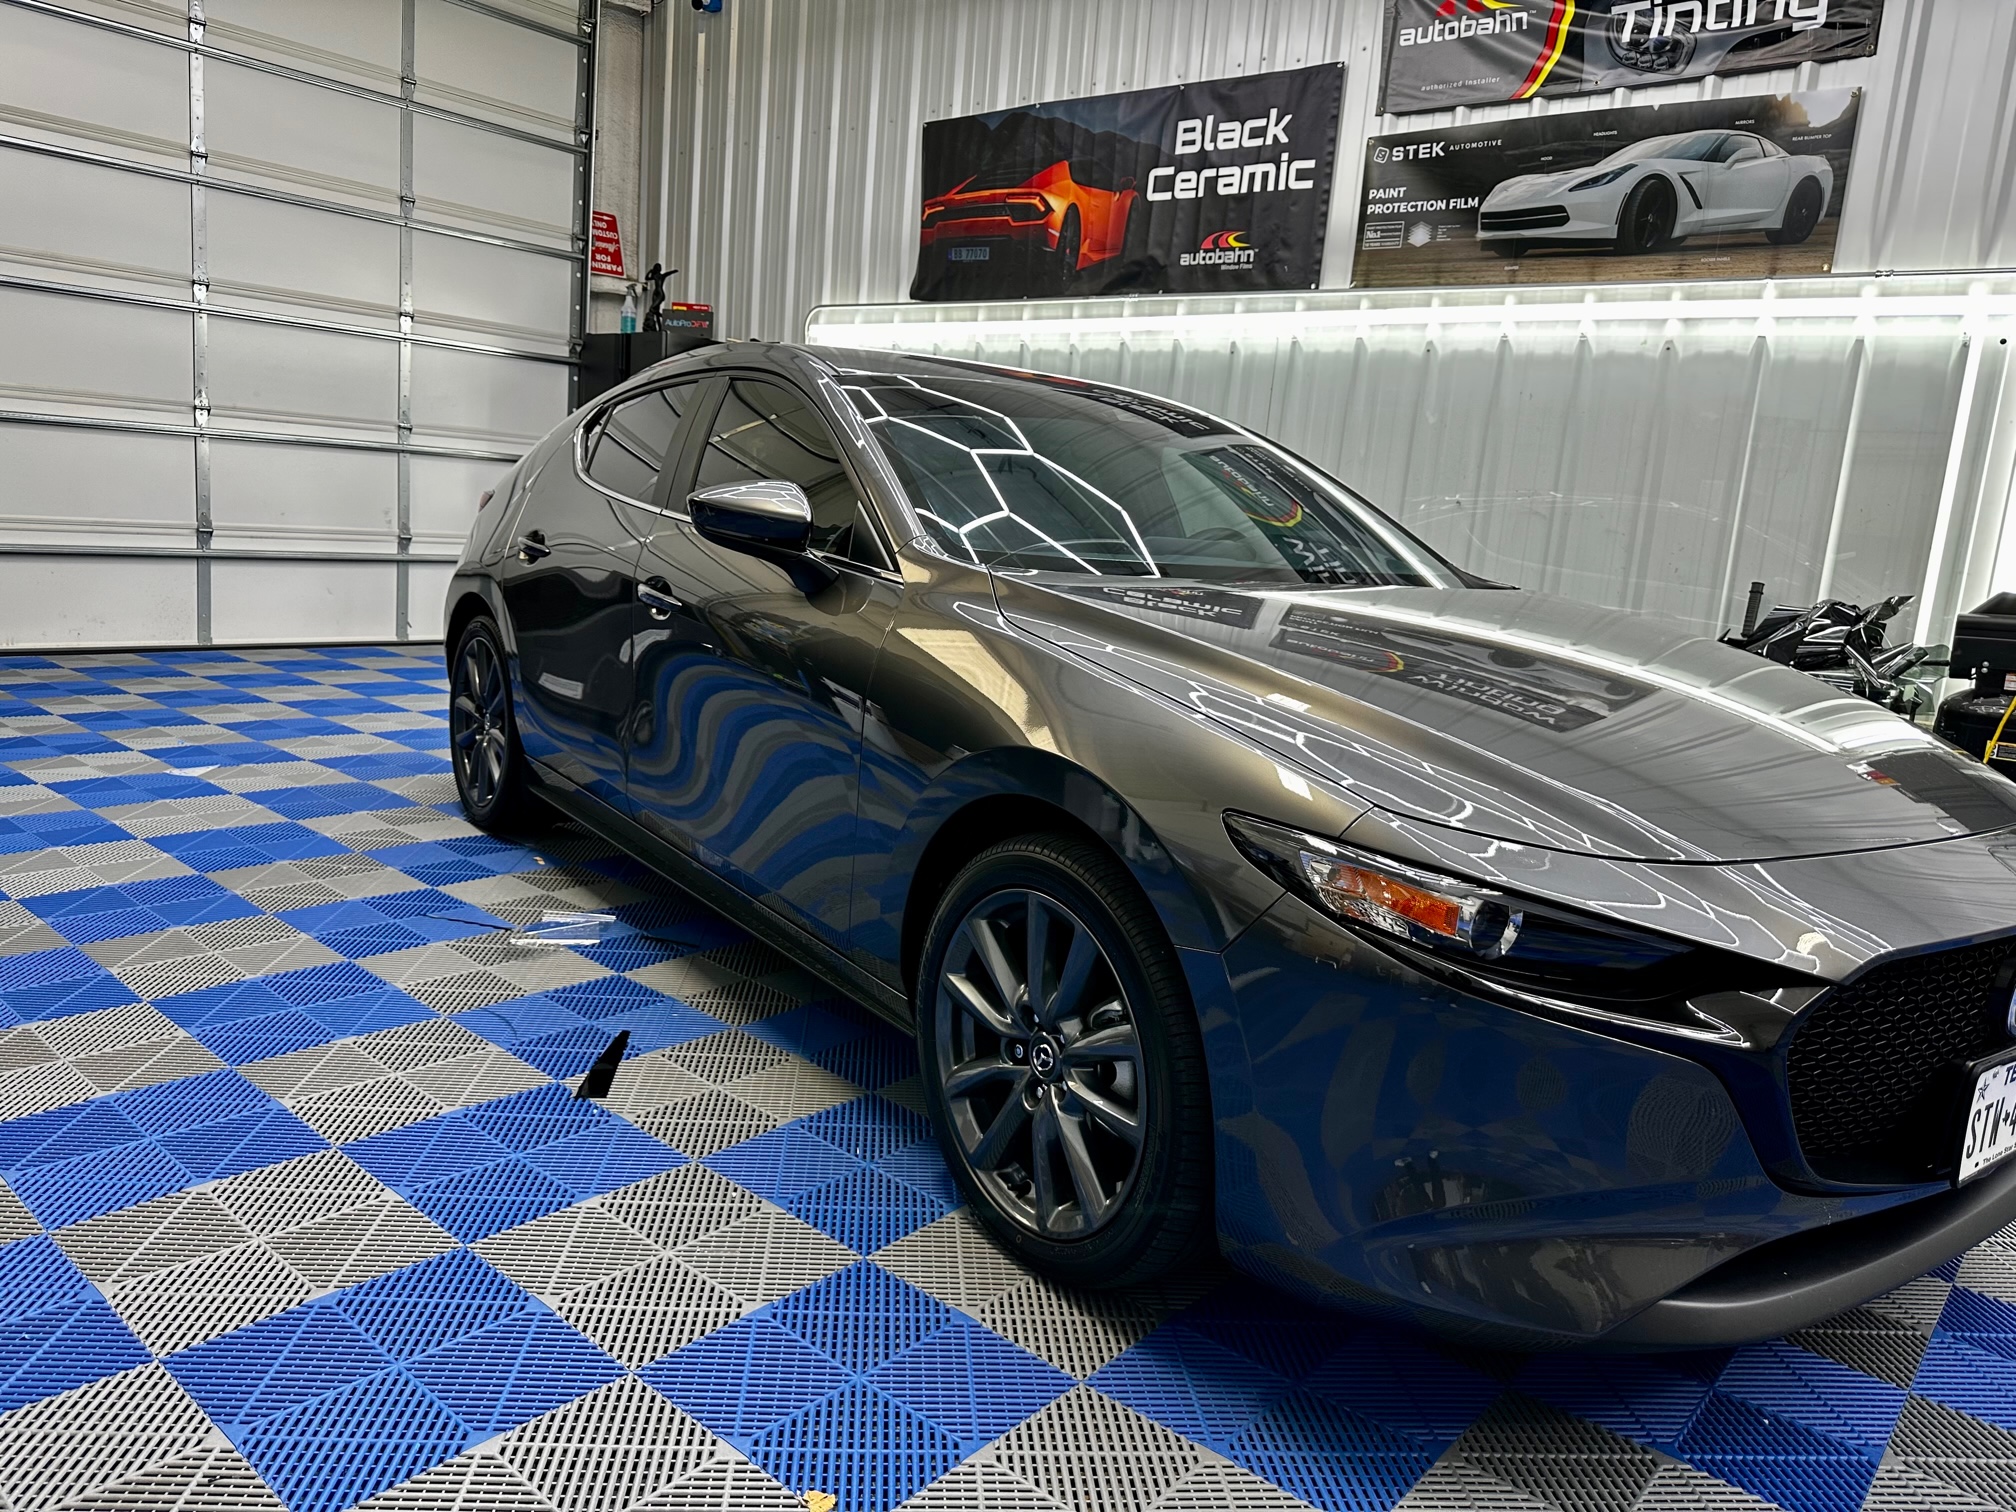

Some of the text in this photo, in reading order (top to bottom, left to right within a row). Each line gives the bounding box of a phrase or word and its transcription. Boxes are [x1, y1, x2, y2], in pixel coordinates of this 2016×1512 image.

[1399, 10, 1528, 47] autobahn
[1611, 0, 1828, 43] Tinting
[1420, 76, 1501, 92] authorized Installer
[1174, 107, 1293, 155] Black
[1391, 139, 1503, 162] STEK AUTOMOTIVE
[1146, 152, 1316, 202] Ceramic
[1368, 187, 1407, 200] PAINT
[1366, 197, 1480, 215] PROTECTION FILM
[595, 253, 611, 262] FOR
[1180, 247, 1255, 266] autobahn
[591, 261, 623, 273] PARKIN
[1982, 1156, 1992, 1166] The
[1992, 1150, 2004, 1161] Lone
